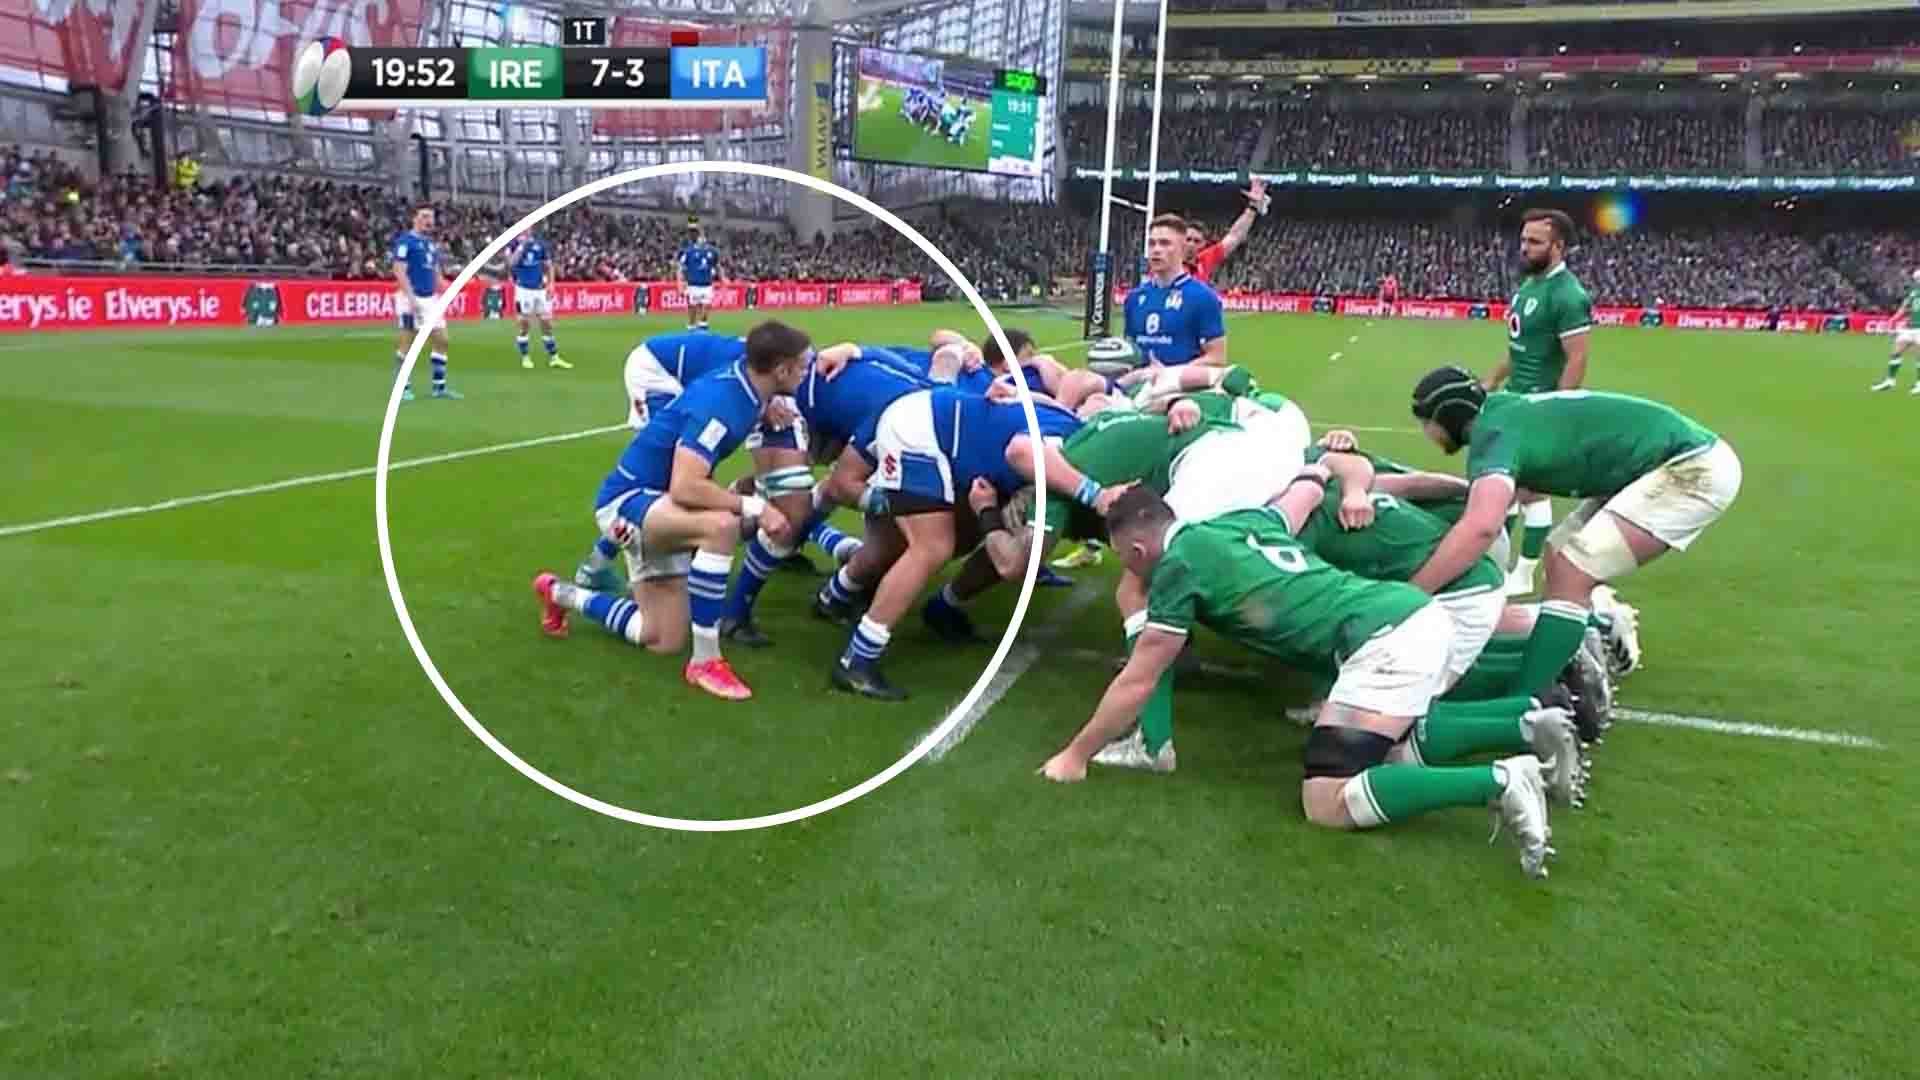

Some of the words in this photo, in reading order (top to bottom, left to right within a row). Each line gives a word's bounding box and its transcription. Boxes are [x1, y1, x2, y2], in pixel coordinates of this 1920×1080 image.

[105, 288, 220, 325] Elverys.ie
[306, 291, 393, 318] CELEBRA
[1246, 532, 1309, 573] 6
